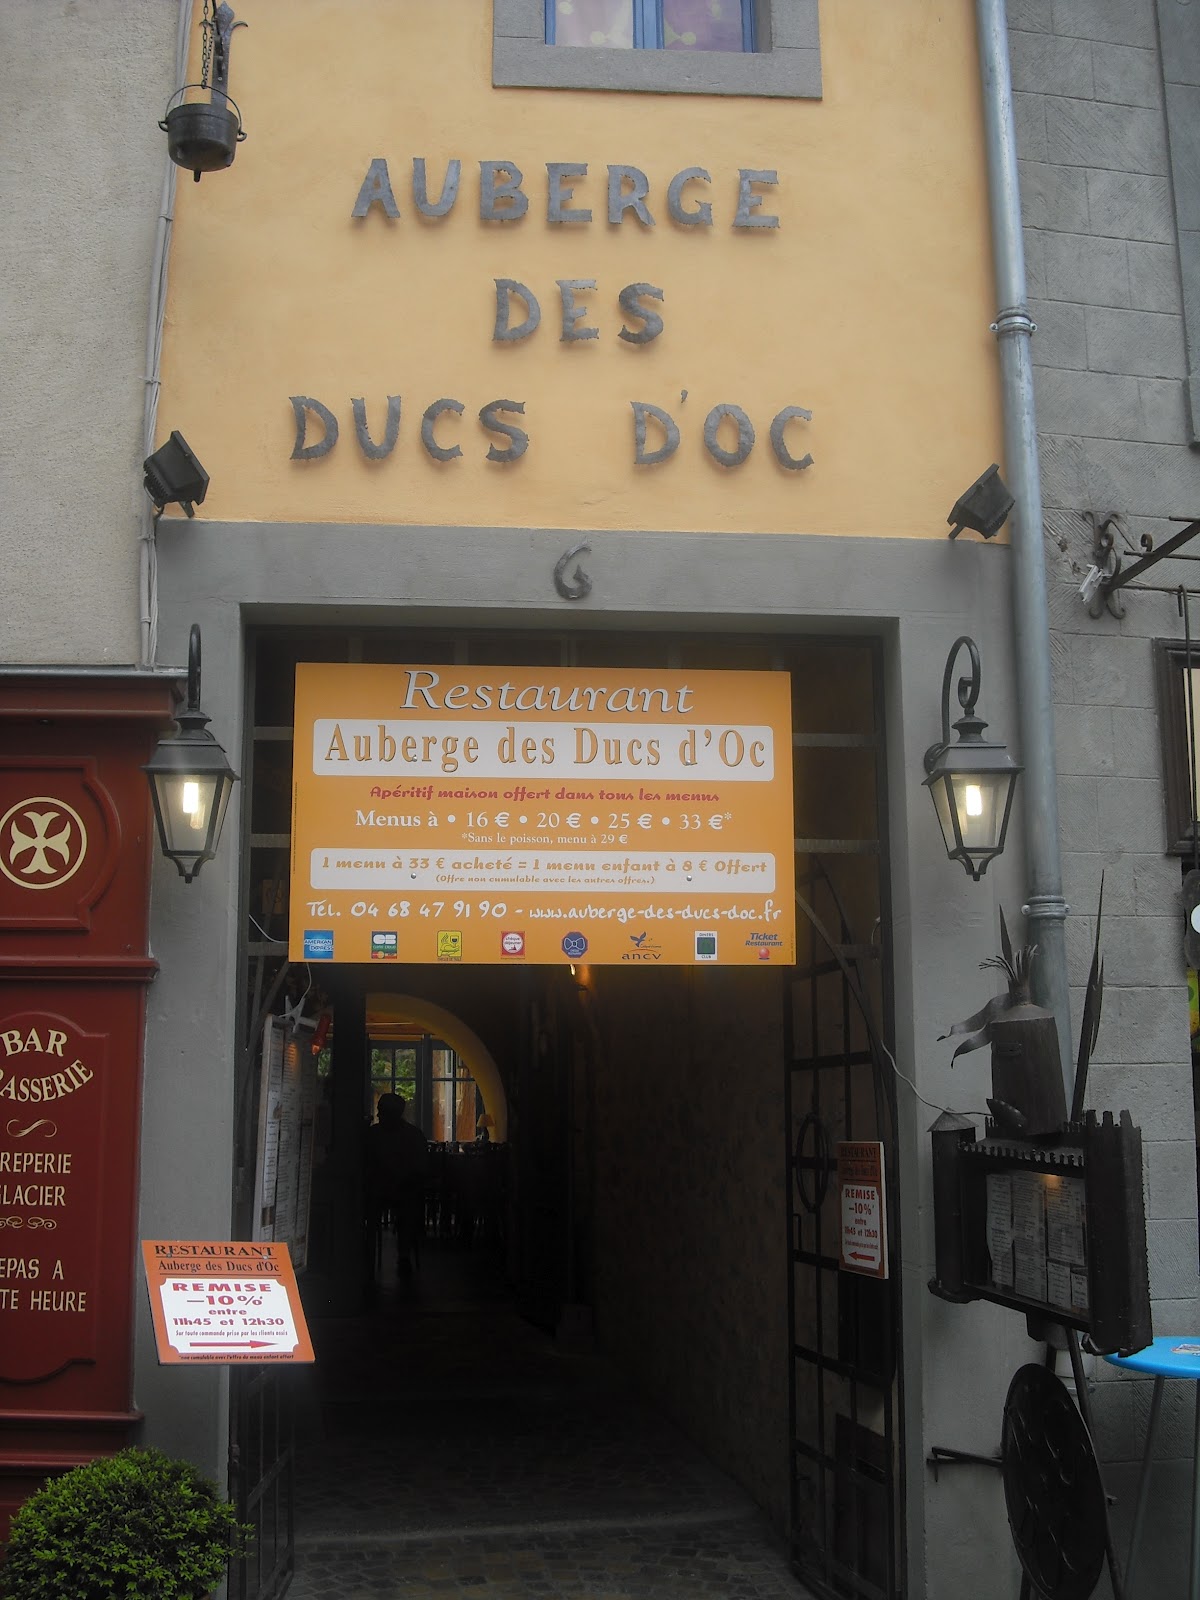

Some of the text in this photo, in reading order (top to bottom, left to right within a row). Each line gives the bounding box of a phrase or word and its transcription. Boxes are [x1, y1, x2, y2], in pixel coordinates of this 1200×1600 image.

[351, 157, 780, 228] AUBERGE
[492, 278, 664, 344] DES
[289, 389, 814, 470] DUCS D'OC
[400, 670, 694, 713] Restaurant
[325, 723, 764, 773] Auberge des Ducs d'Oc
[370, 785, 719, 802] Apéritif maison offert dans tous les menus
[356, 810, 421, 827] Menus
[428, 811, 439, 827] à
[467, 811, 488, 828] 16
[494, 811, 510, 828] €
[536, 812, 560, 828] 20
[566, 813, 581, 829] €
[608, 813, 630, 829] 25
[637, 813, 652, 829] €
[679, 814, 701, 830] 33
[497, 833, 506, 843] le
[510, 834, 553, 846] poisson,
[557, 836, 587, 844] menu
[590, 834, 597, 844] à
[601, 834, 615, 844] 29
[619, 835, 628, 844] €
[322, 857, 329, 868] 1
[336, 859, 386, 869] menu
[392, 856, 402, 869] à
[409, 858, 430, 869] 33
[435, 857, 445, 869] €
[451, 856, 513, 870] acheté
[532, 857, 540, 870] 1
[546, 860, 596, 871] menu
[601, 858, 660, 873] enfant
[665, 858, 676, 872] à
[682, 860, 693, 872] 8
[699, 860, 708, 872] €
[714, 859, 767, 875] Offert
[436, 874, 465, 884] (Offre
[306, 899, 341, 917] Tél.
[351, 901, 379, 917] 04
[388, 901, 411, 917] 68
[419, 901, 445, 918] 47
[453, 900, 471, 918] 91
[479, 900, 507, 918] 90
[529, 899, 782, 924] www.auberge-des-ducs-doc.fr
[750, 932, 778, 941] Ticket
[0, 1027, 68, 1057] BAR
[0, 1059, 94, 1102] ASSERIE
[0, 1184, 66, 1207] LACIER
[845, 1188, 875, 1200] REMISE
[155, 1245, 274, 1256] RESTAURANT
[52, 1259, 64, 1280] A
[158, 1260, 279, 1272] Auberge des Ducs d'Oc
[172, 1282, 271, 1292] REMISE
[30, 1290, 87, 1312] HEURE
[173, 1317, 284, 1326] 11h45 et 12h30
